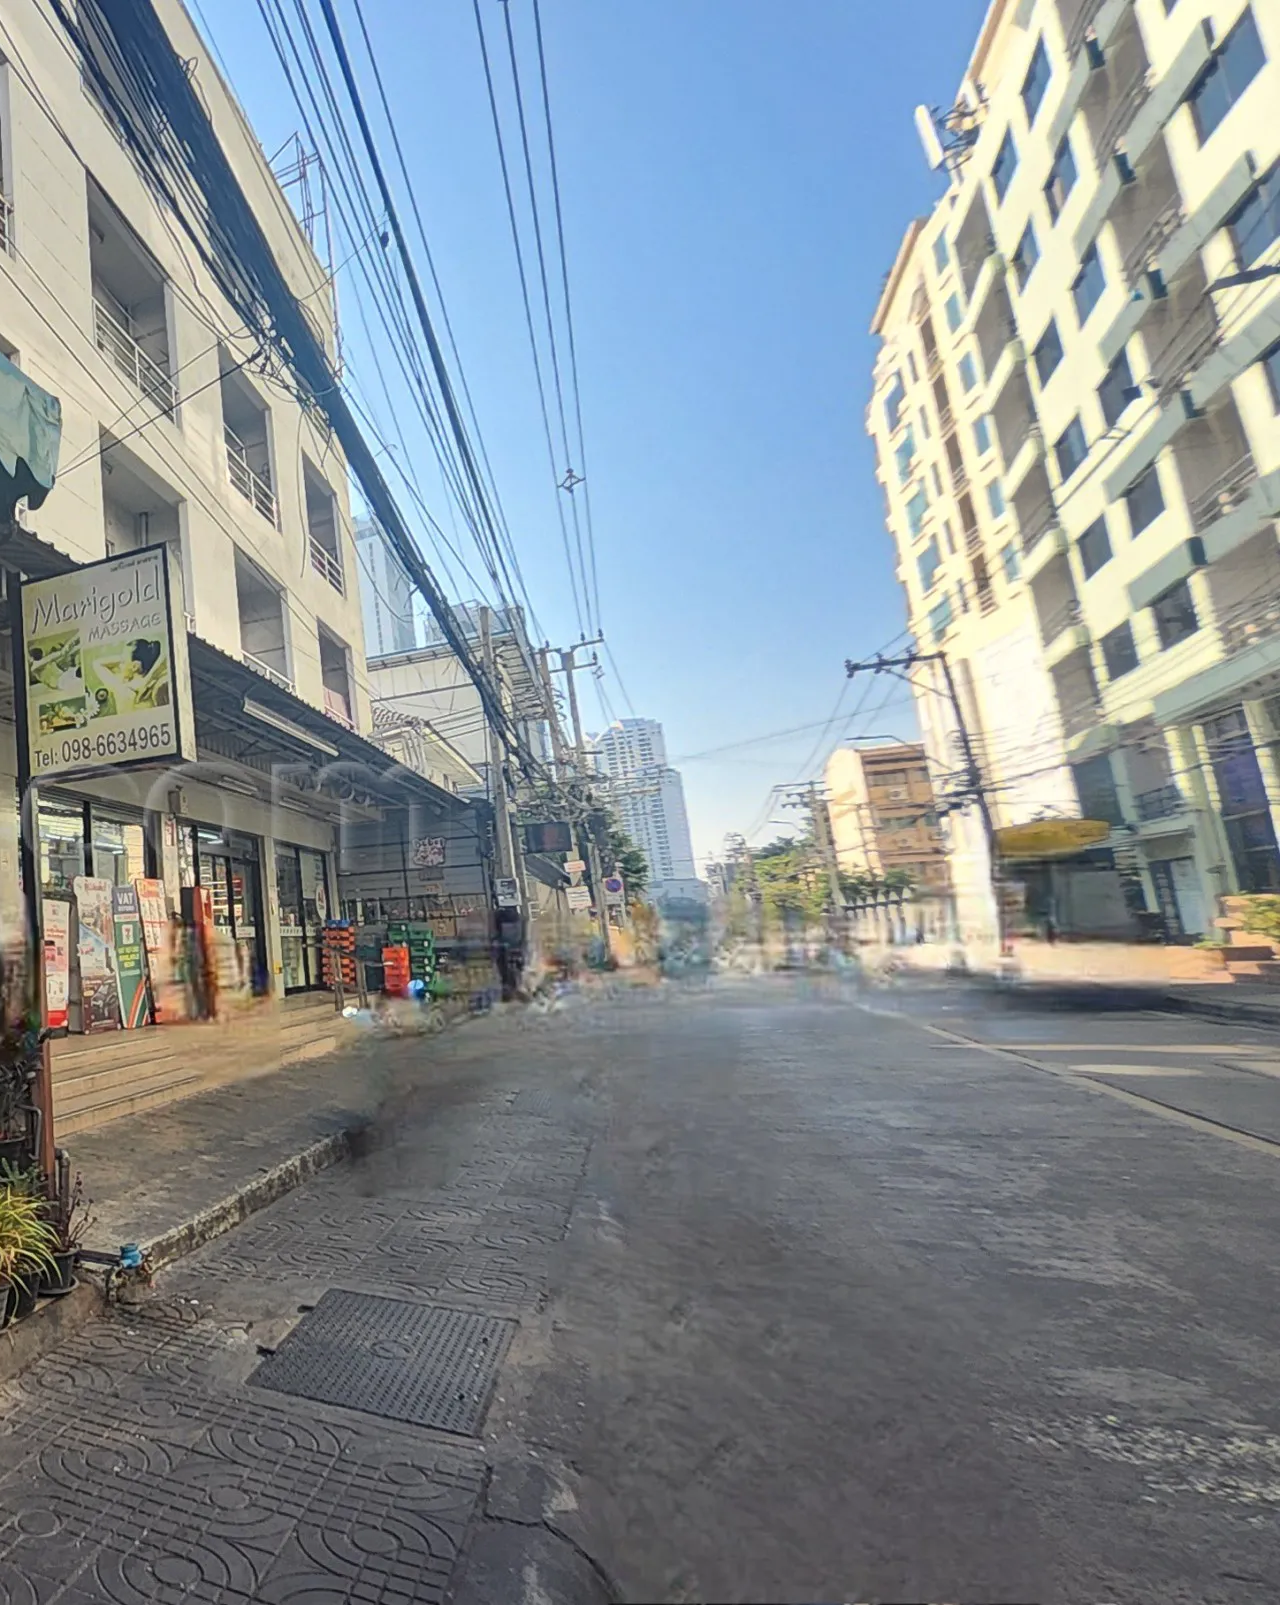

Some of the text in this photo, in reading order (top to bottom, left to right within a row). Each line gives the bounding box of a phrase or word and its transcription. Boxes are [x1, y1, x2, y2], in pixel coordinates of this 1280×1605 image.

[31, 564, 161, 635] Marigold
[88, 612, 162, 643] MASSAGE
[35, 722, 171, 768] Tel: 098-6634965
[116, 892, 134, 905] VAT
